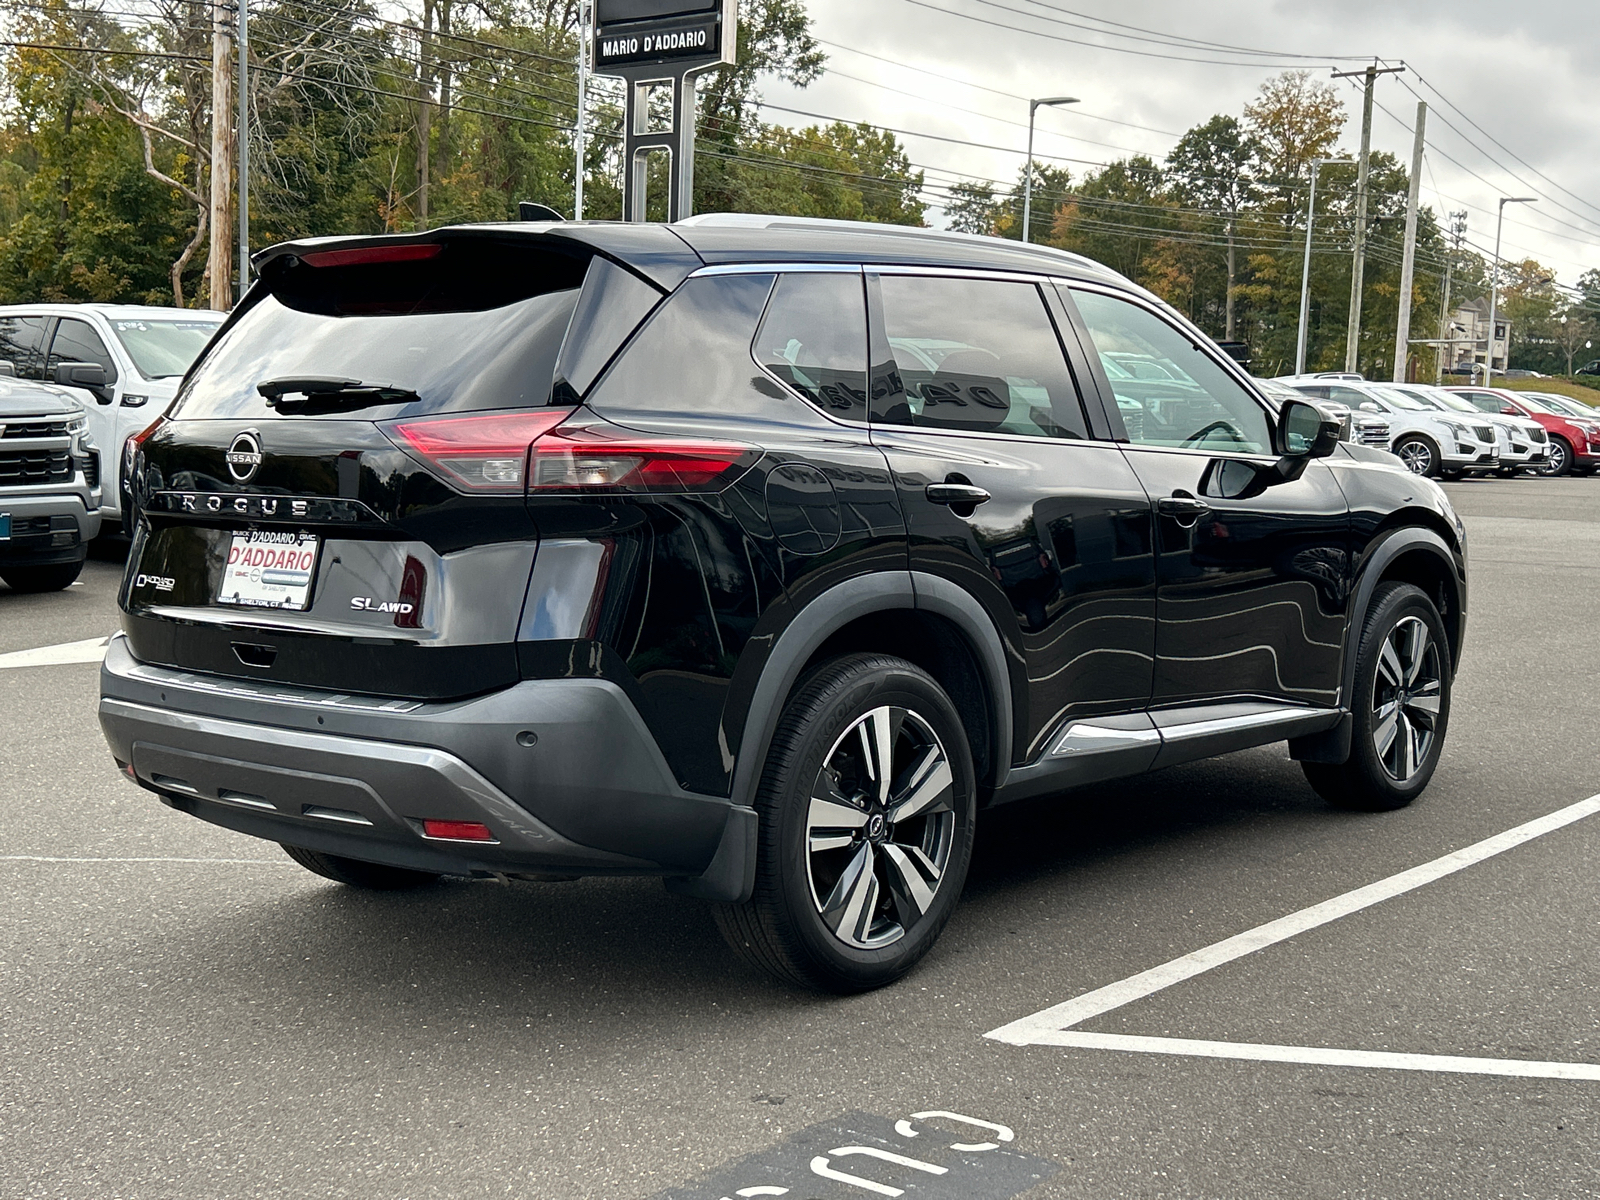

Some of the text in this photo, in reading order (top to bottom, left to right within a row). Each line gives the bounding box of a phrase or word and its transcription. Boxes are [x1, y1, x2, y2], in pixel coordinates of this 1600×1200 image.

[602, 30, 706, 57] MARIO D'ADDARIO
[226, 454, 261, 464] NISSAN
[181, 495, 307, 516] ROGUE
[251, 531, 295, 544] D'ADDARIO
[227, 546, 314, 571] D'ADDARIO
[350, 597, 413, 614] SL AWD
